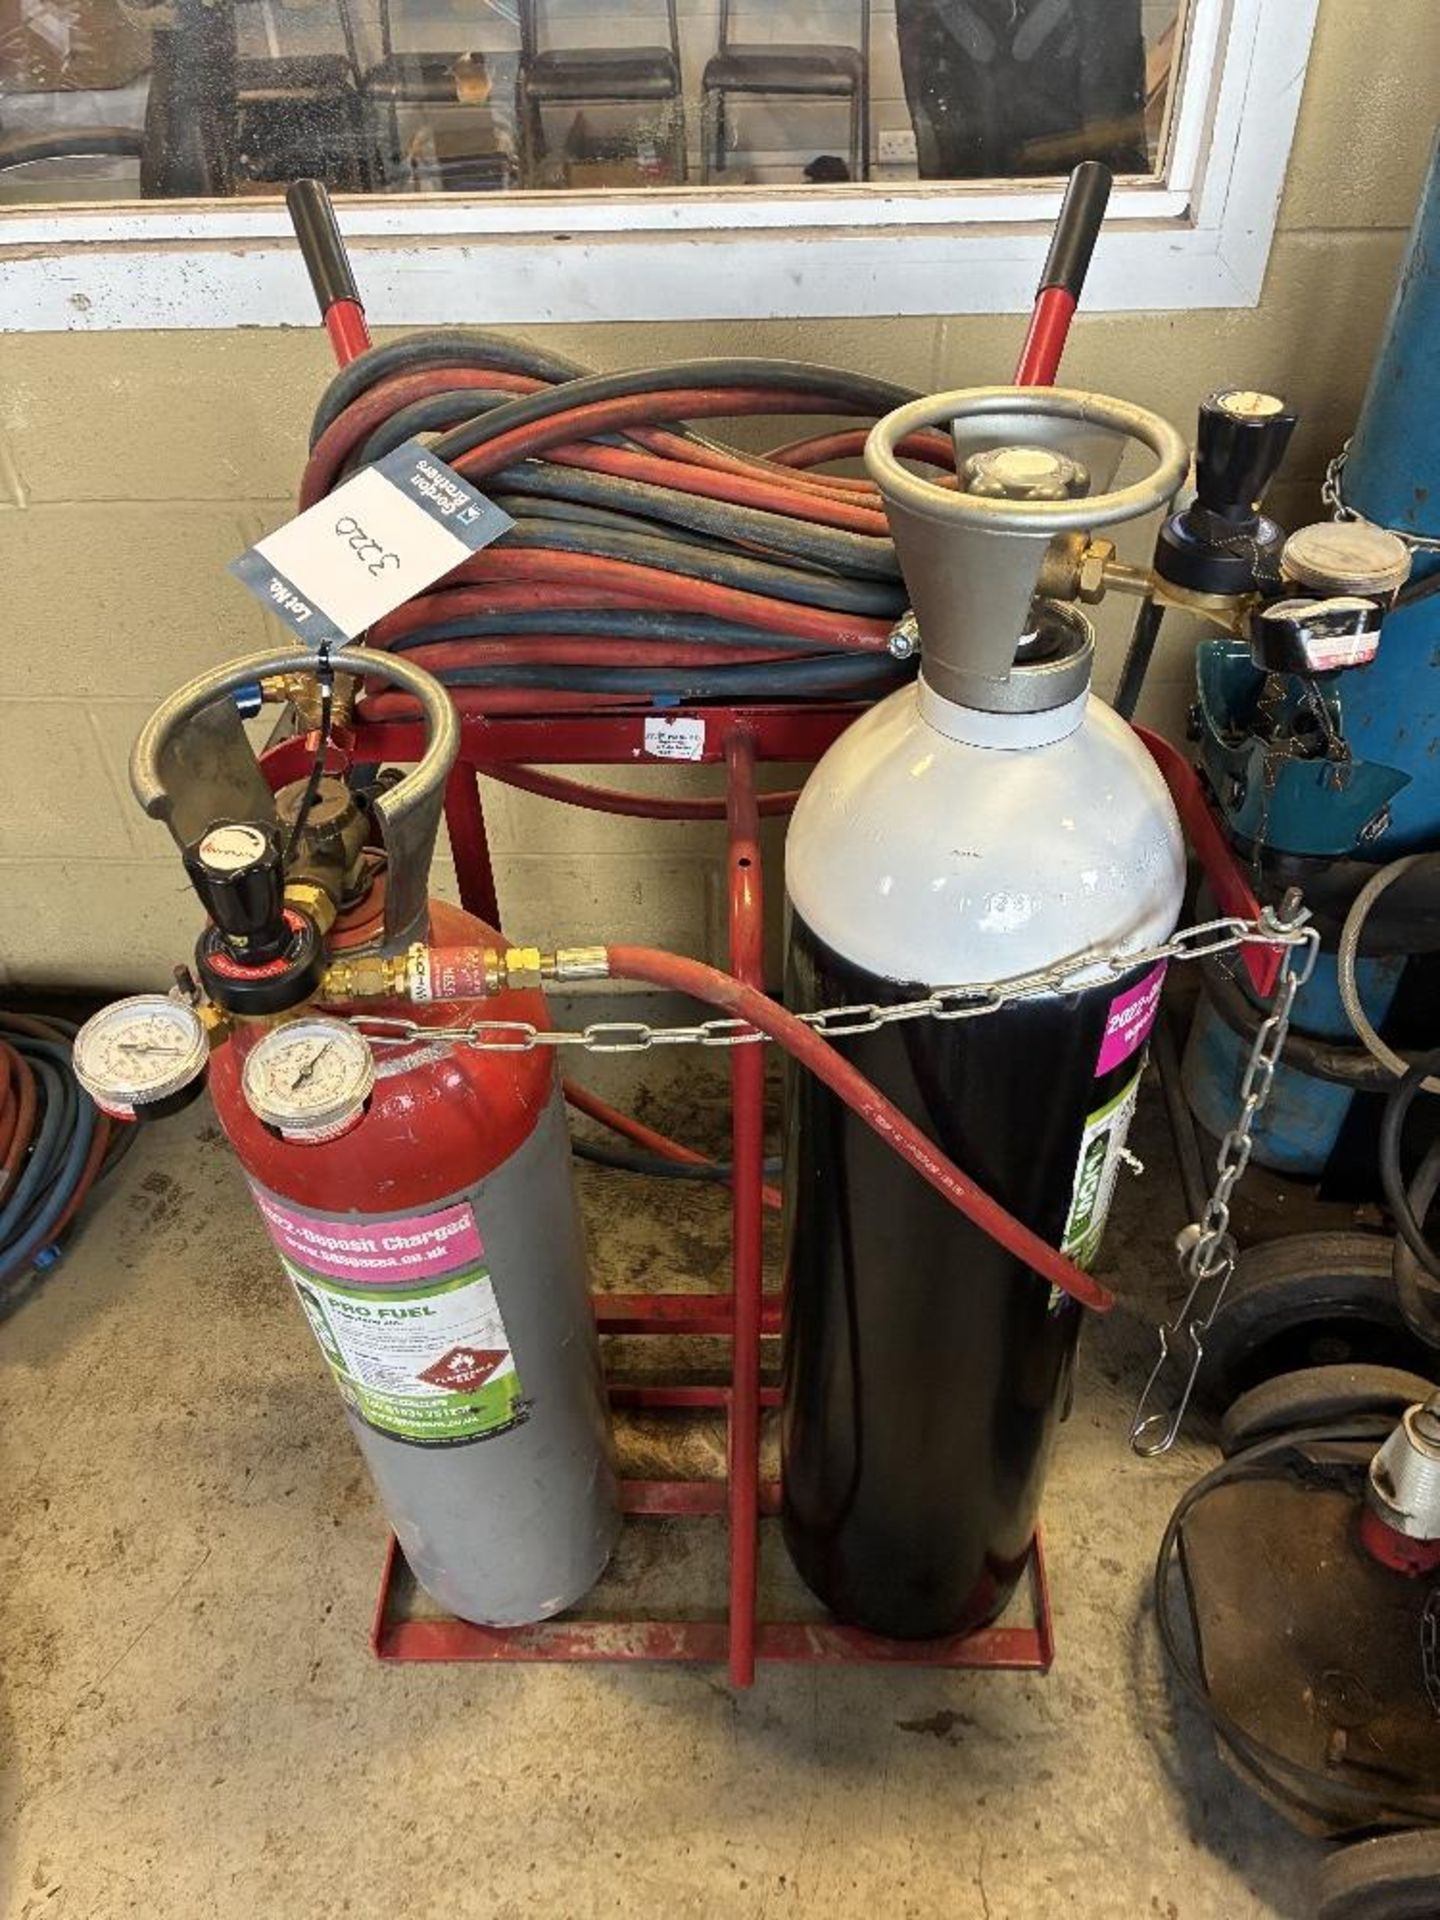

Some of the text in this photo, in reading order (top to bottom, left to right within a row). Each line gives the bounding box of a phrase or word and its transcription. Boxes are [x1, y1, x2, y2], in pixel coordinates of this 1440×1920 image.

[411, 475, 457, 516] Gordon
[416, 460, 471, 510] Brothers
[335, 516, 400, 577] 3220
[269, 577, 313, 623] Lot No.
[381, 1214, 472, 1251] Charged
[328, 1298, 372, 1317] PRO
[377, 1305, 437, 1320] FUEL
